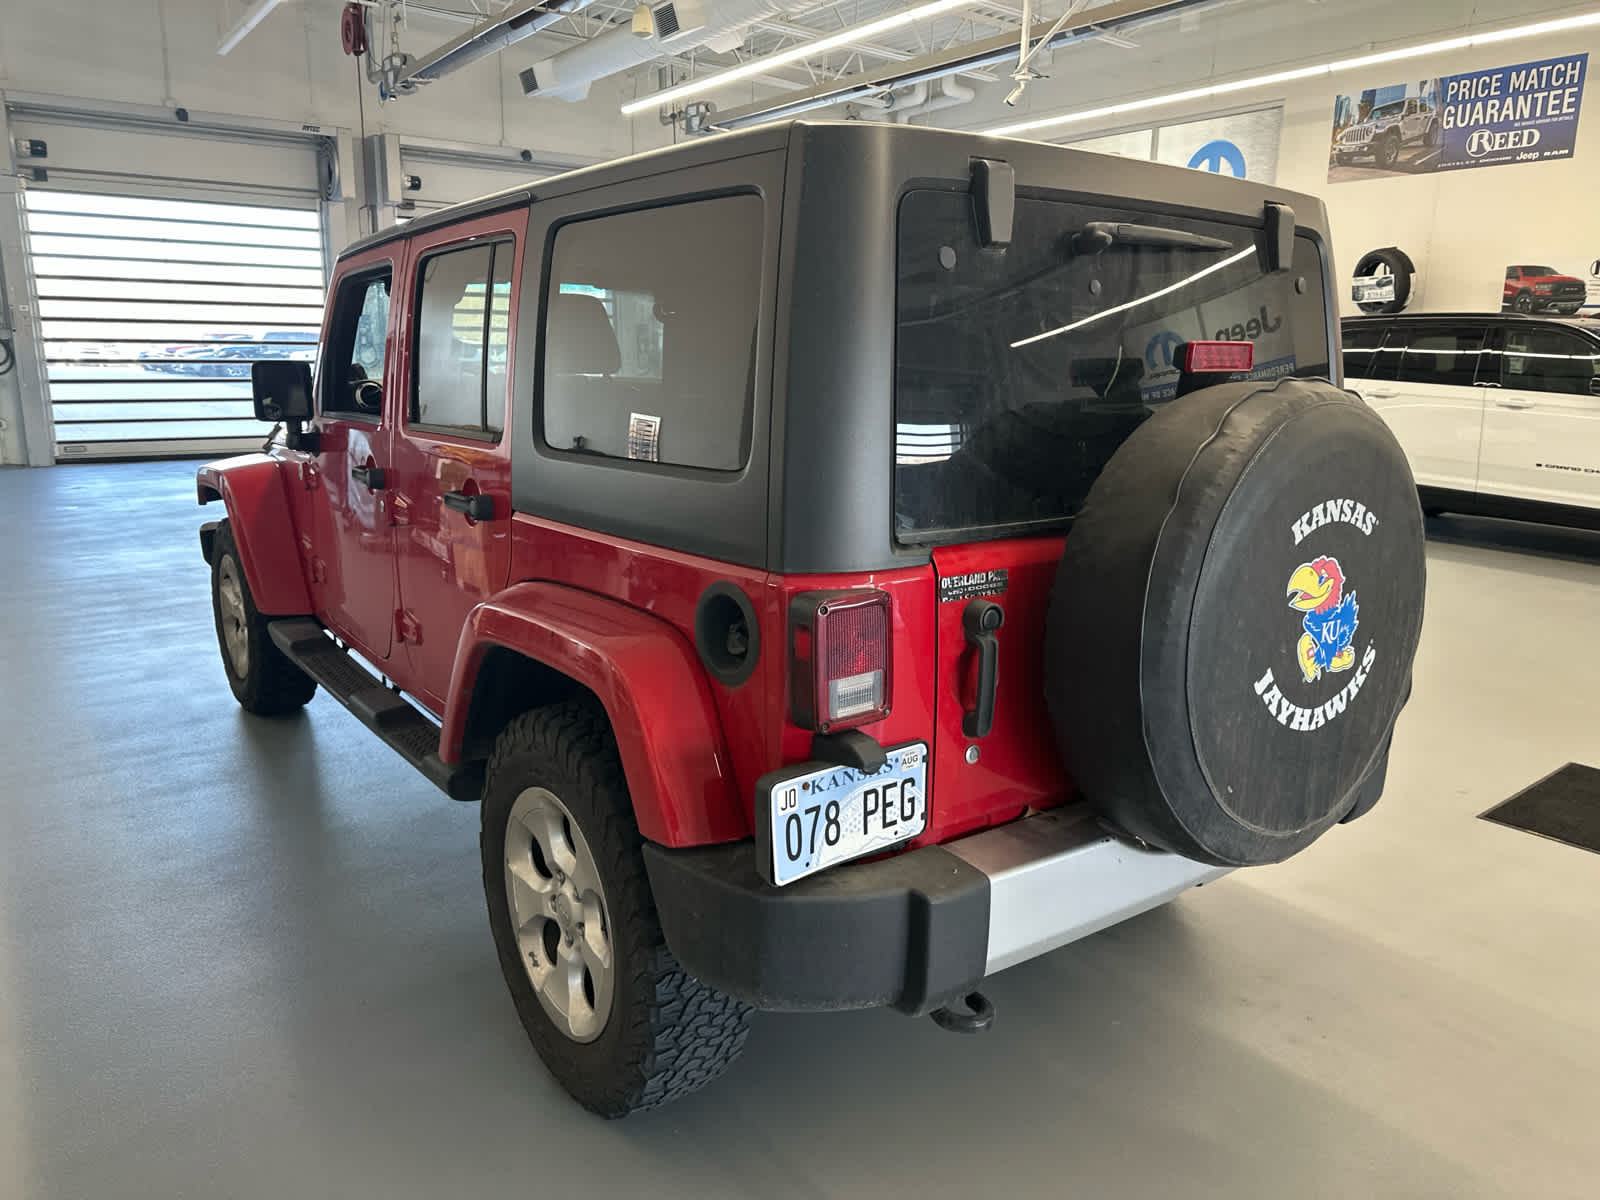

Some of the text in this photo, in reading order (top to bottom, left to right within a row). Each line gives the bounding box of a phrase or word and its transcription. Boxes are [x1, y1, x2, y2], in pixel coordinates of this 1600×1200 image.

[1447, 60, 1581, 103] PRICE MATCH
[1442, 87, 1580, 130] GUARANTEE
[1467, 127, 1542, 157] REED
[1516, 151, 1540, 161] Jeep
[1291, 499, 1376, 546] KANSAS
[941, 572, 985, 589] OVERLAND
[1320, 619, 1341, 644] KU
[1254, 645, 1376, 732] JAYHAWKS
[902, 755, 918, 766] AUG
[785, 777, 916, 862] 078 PEG
